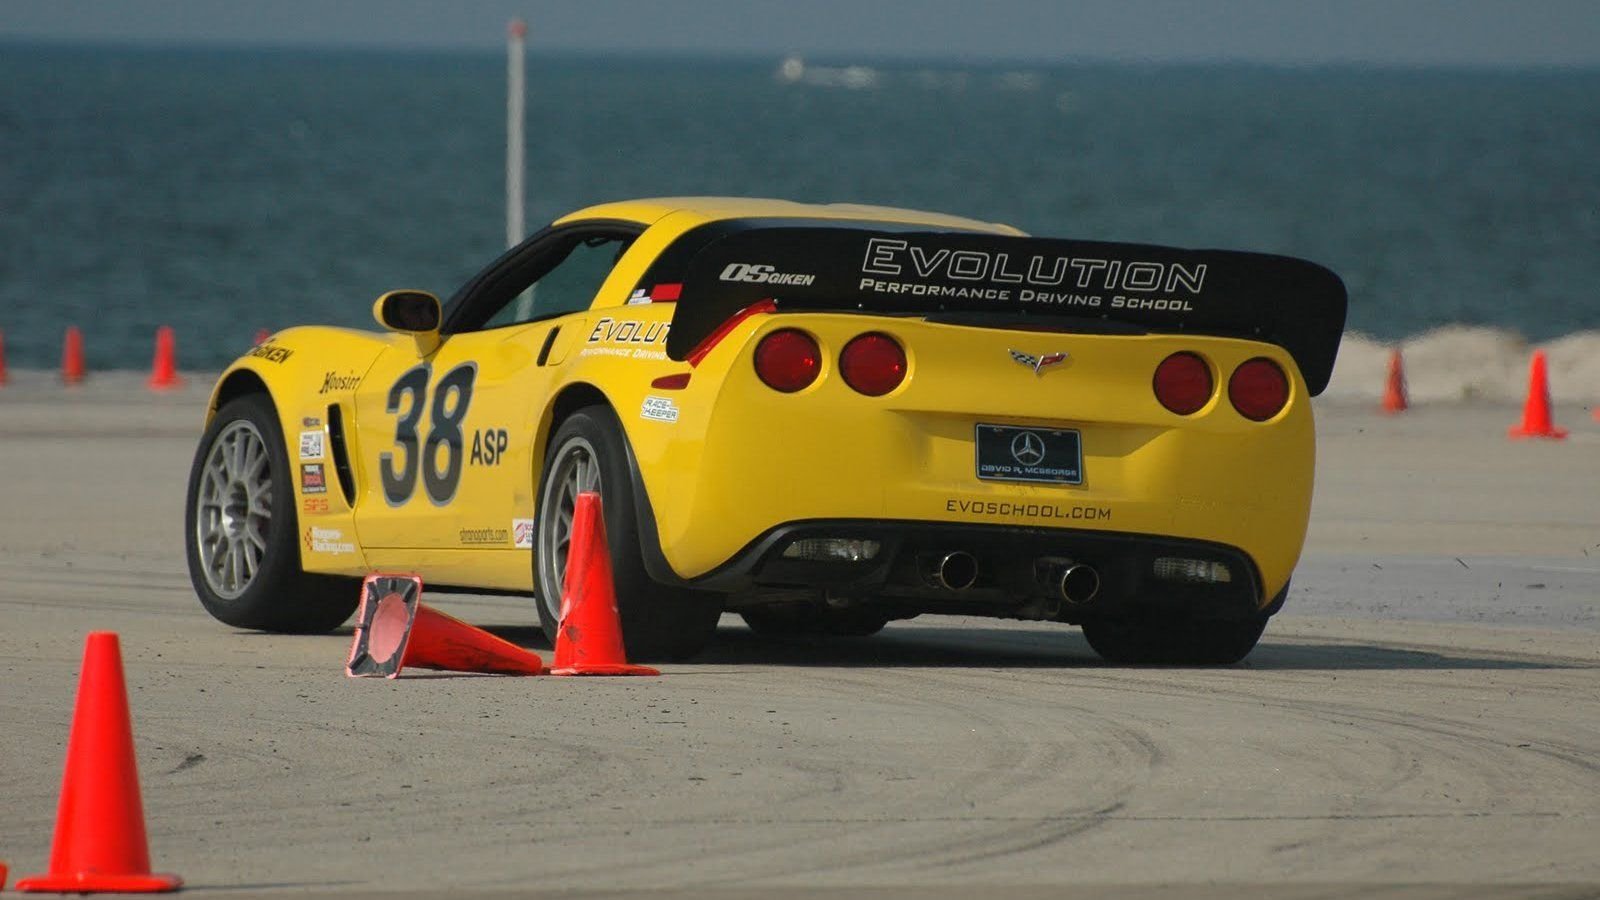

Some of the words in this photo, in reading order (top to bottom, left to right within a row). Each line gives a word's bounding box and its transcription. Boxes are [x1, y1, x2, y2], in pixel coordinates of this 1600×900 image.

[862, 238, 1207, 293] EVOLUTION
[859, 278, 1011, 300] PERFORMANCE
[1020, 289, 1102, 307] DRIVING
[1111, 295, 1194, 311] SCHOOL
[588, 319, 671, 343] EVOLUT
[379, 361, 478, 507] 38
[470, 429, 508, 466] ASP
[946, 500, 1112, 521] EVOSCHOOL.COM
